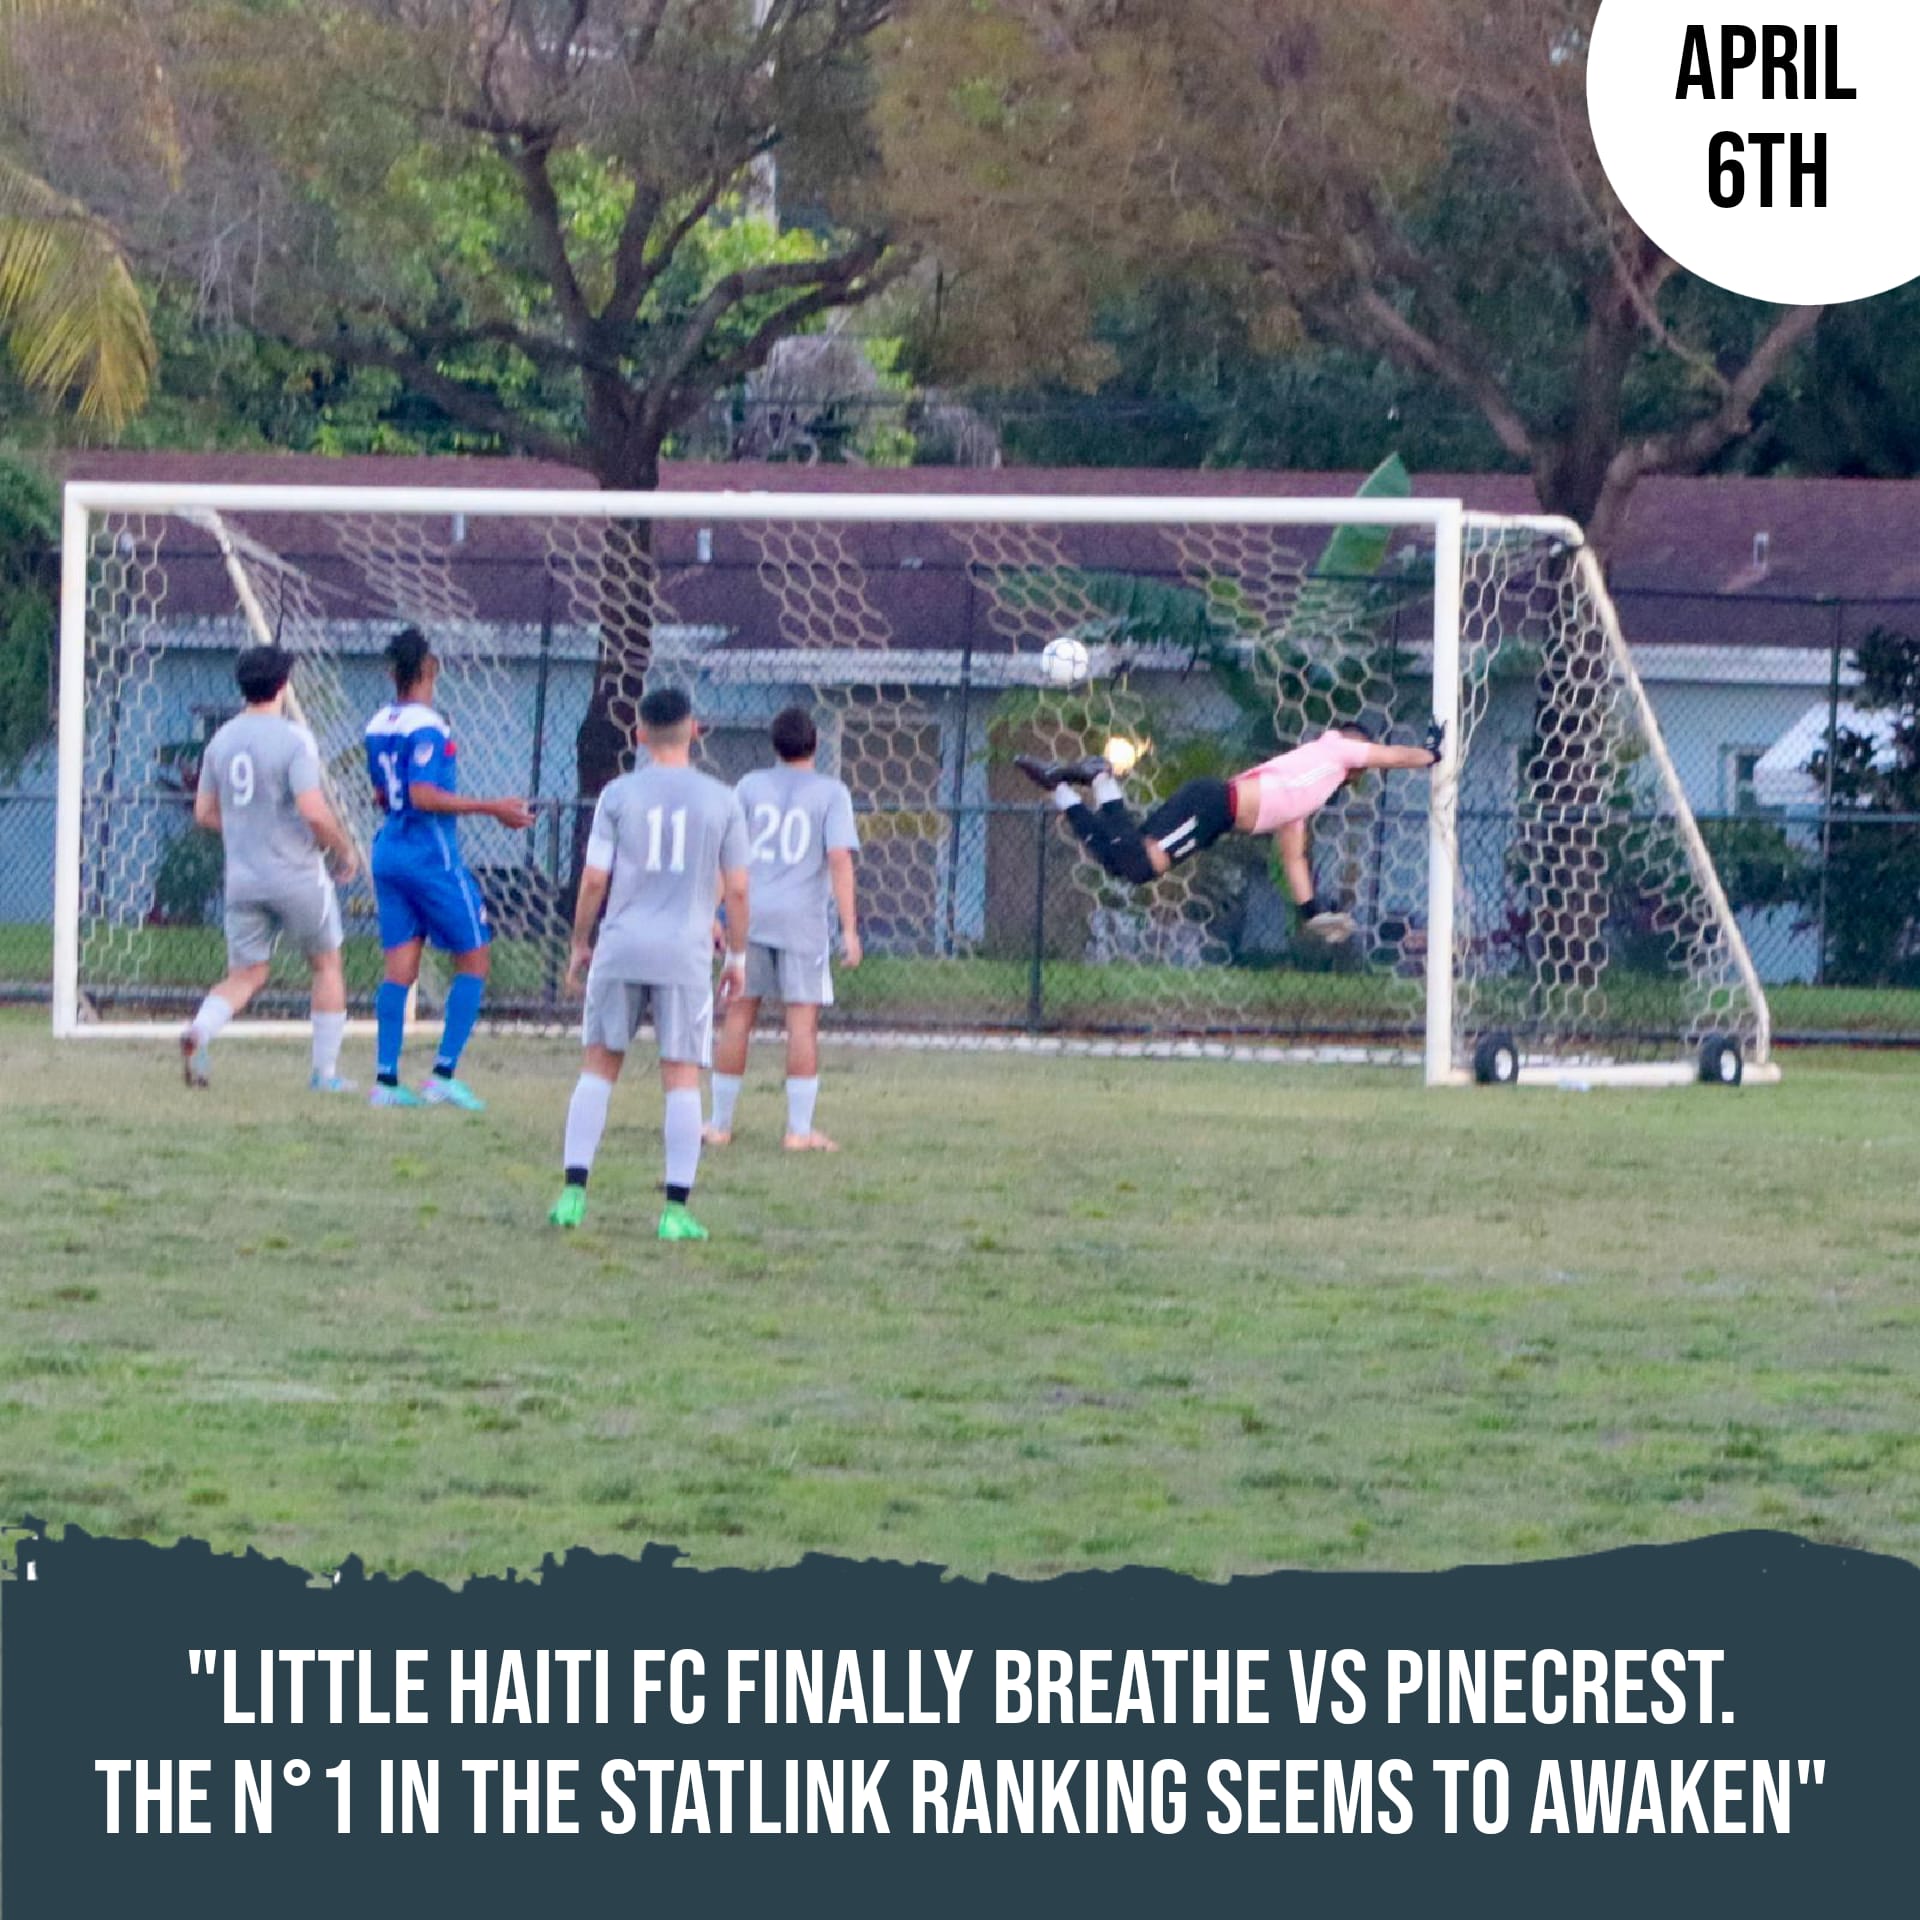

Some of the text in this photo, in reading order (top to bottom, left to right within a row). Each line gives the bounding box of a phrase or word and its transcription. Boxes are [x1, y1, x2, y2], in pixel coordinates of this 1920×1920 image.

[229, 752, 255, 806] 9
[645, 804, 687, 872] 11
[751, 803, 811, 865] 20
